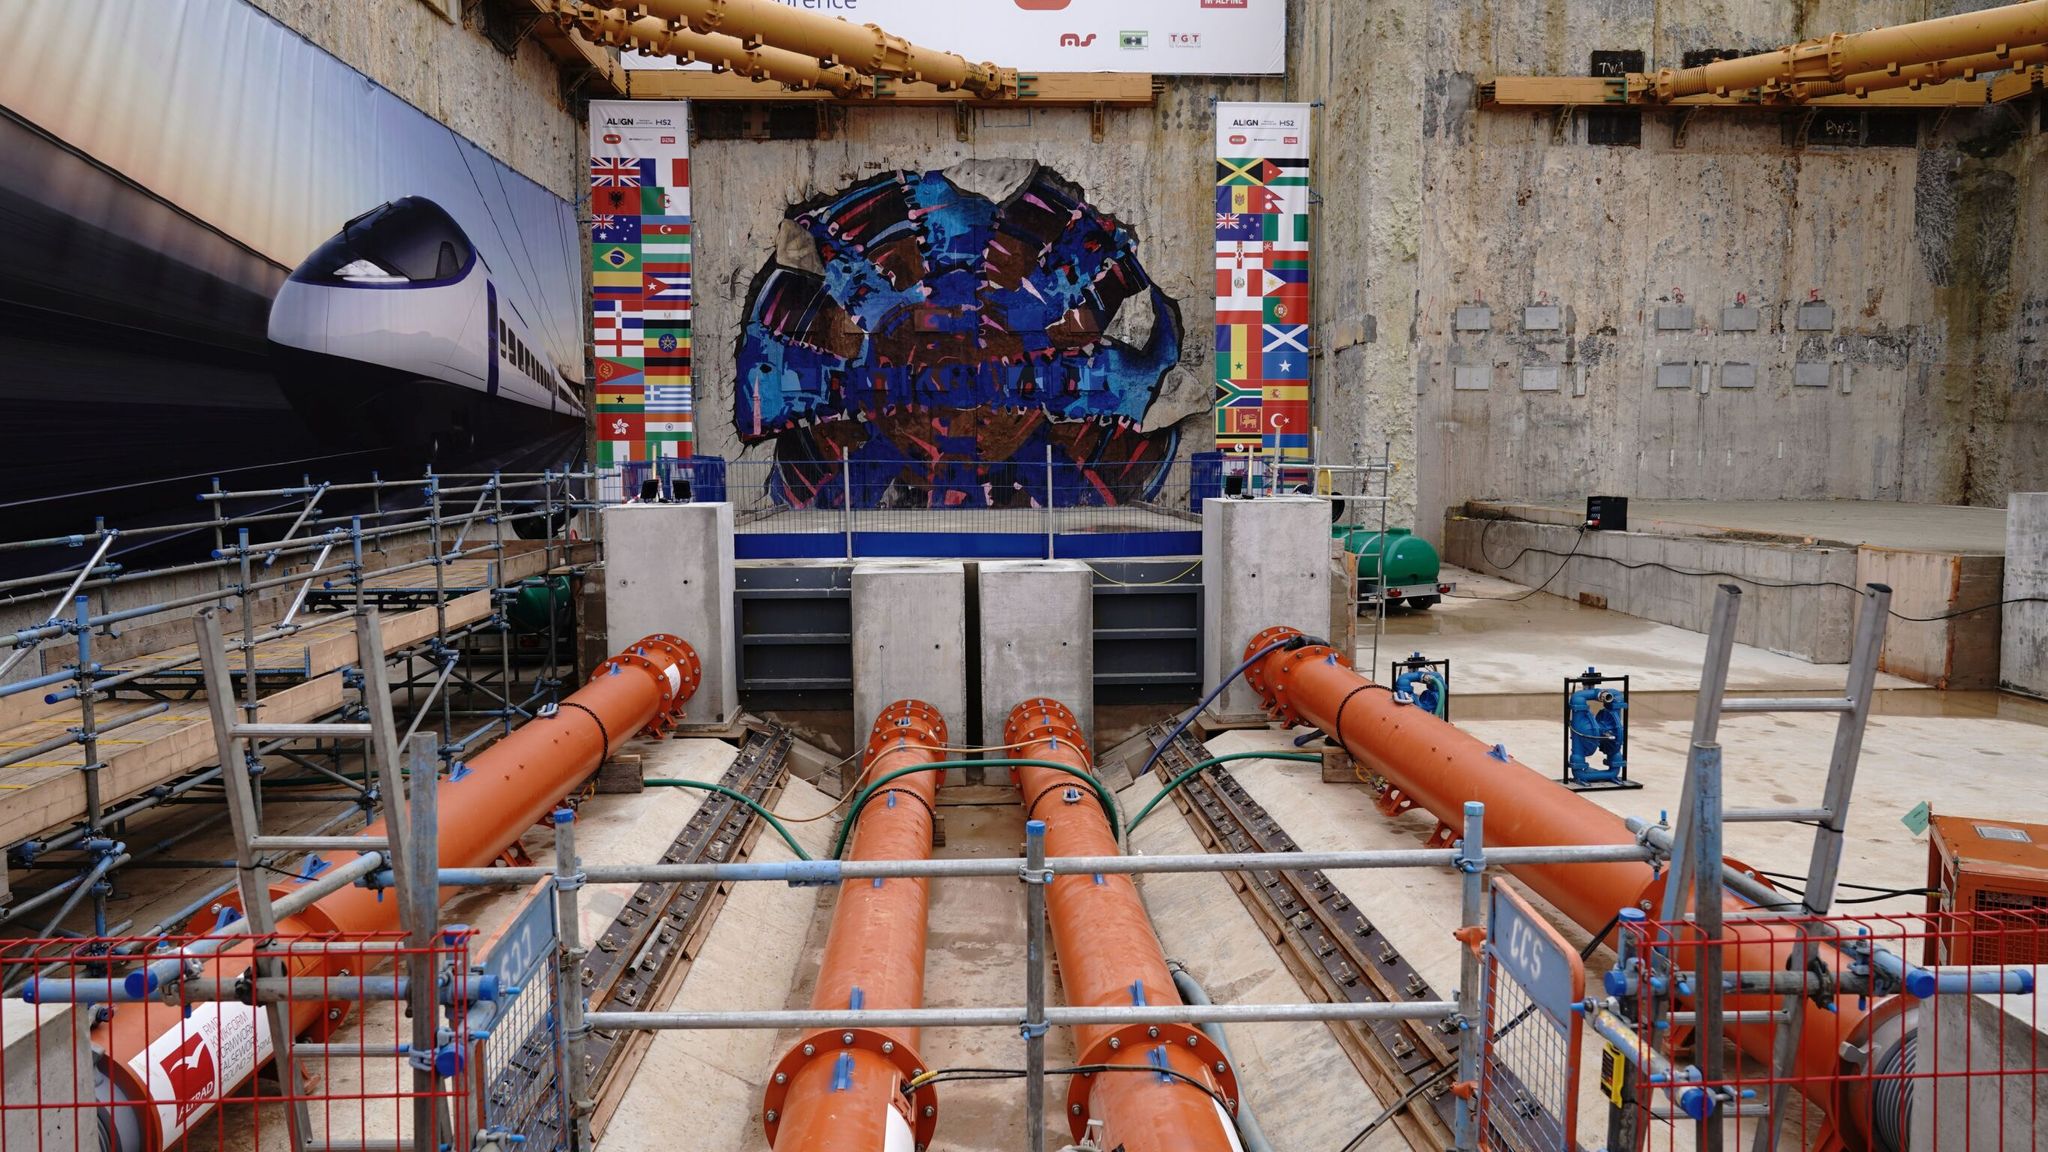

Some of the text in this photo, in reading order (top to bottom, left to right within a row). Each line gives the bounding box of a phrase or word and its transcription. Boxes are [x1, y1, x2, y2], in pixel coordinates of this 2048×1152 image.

[1510, 916, 1544, 980] CCS
[210, 1011, 249, 1049] KIKFORM
[216, 1024, 256, 1059] ORMWORK
